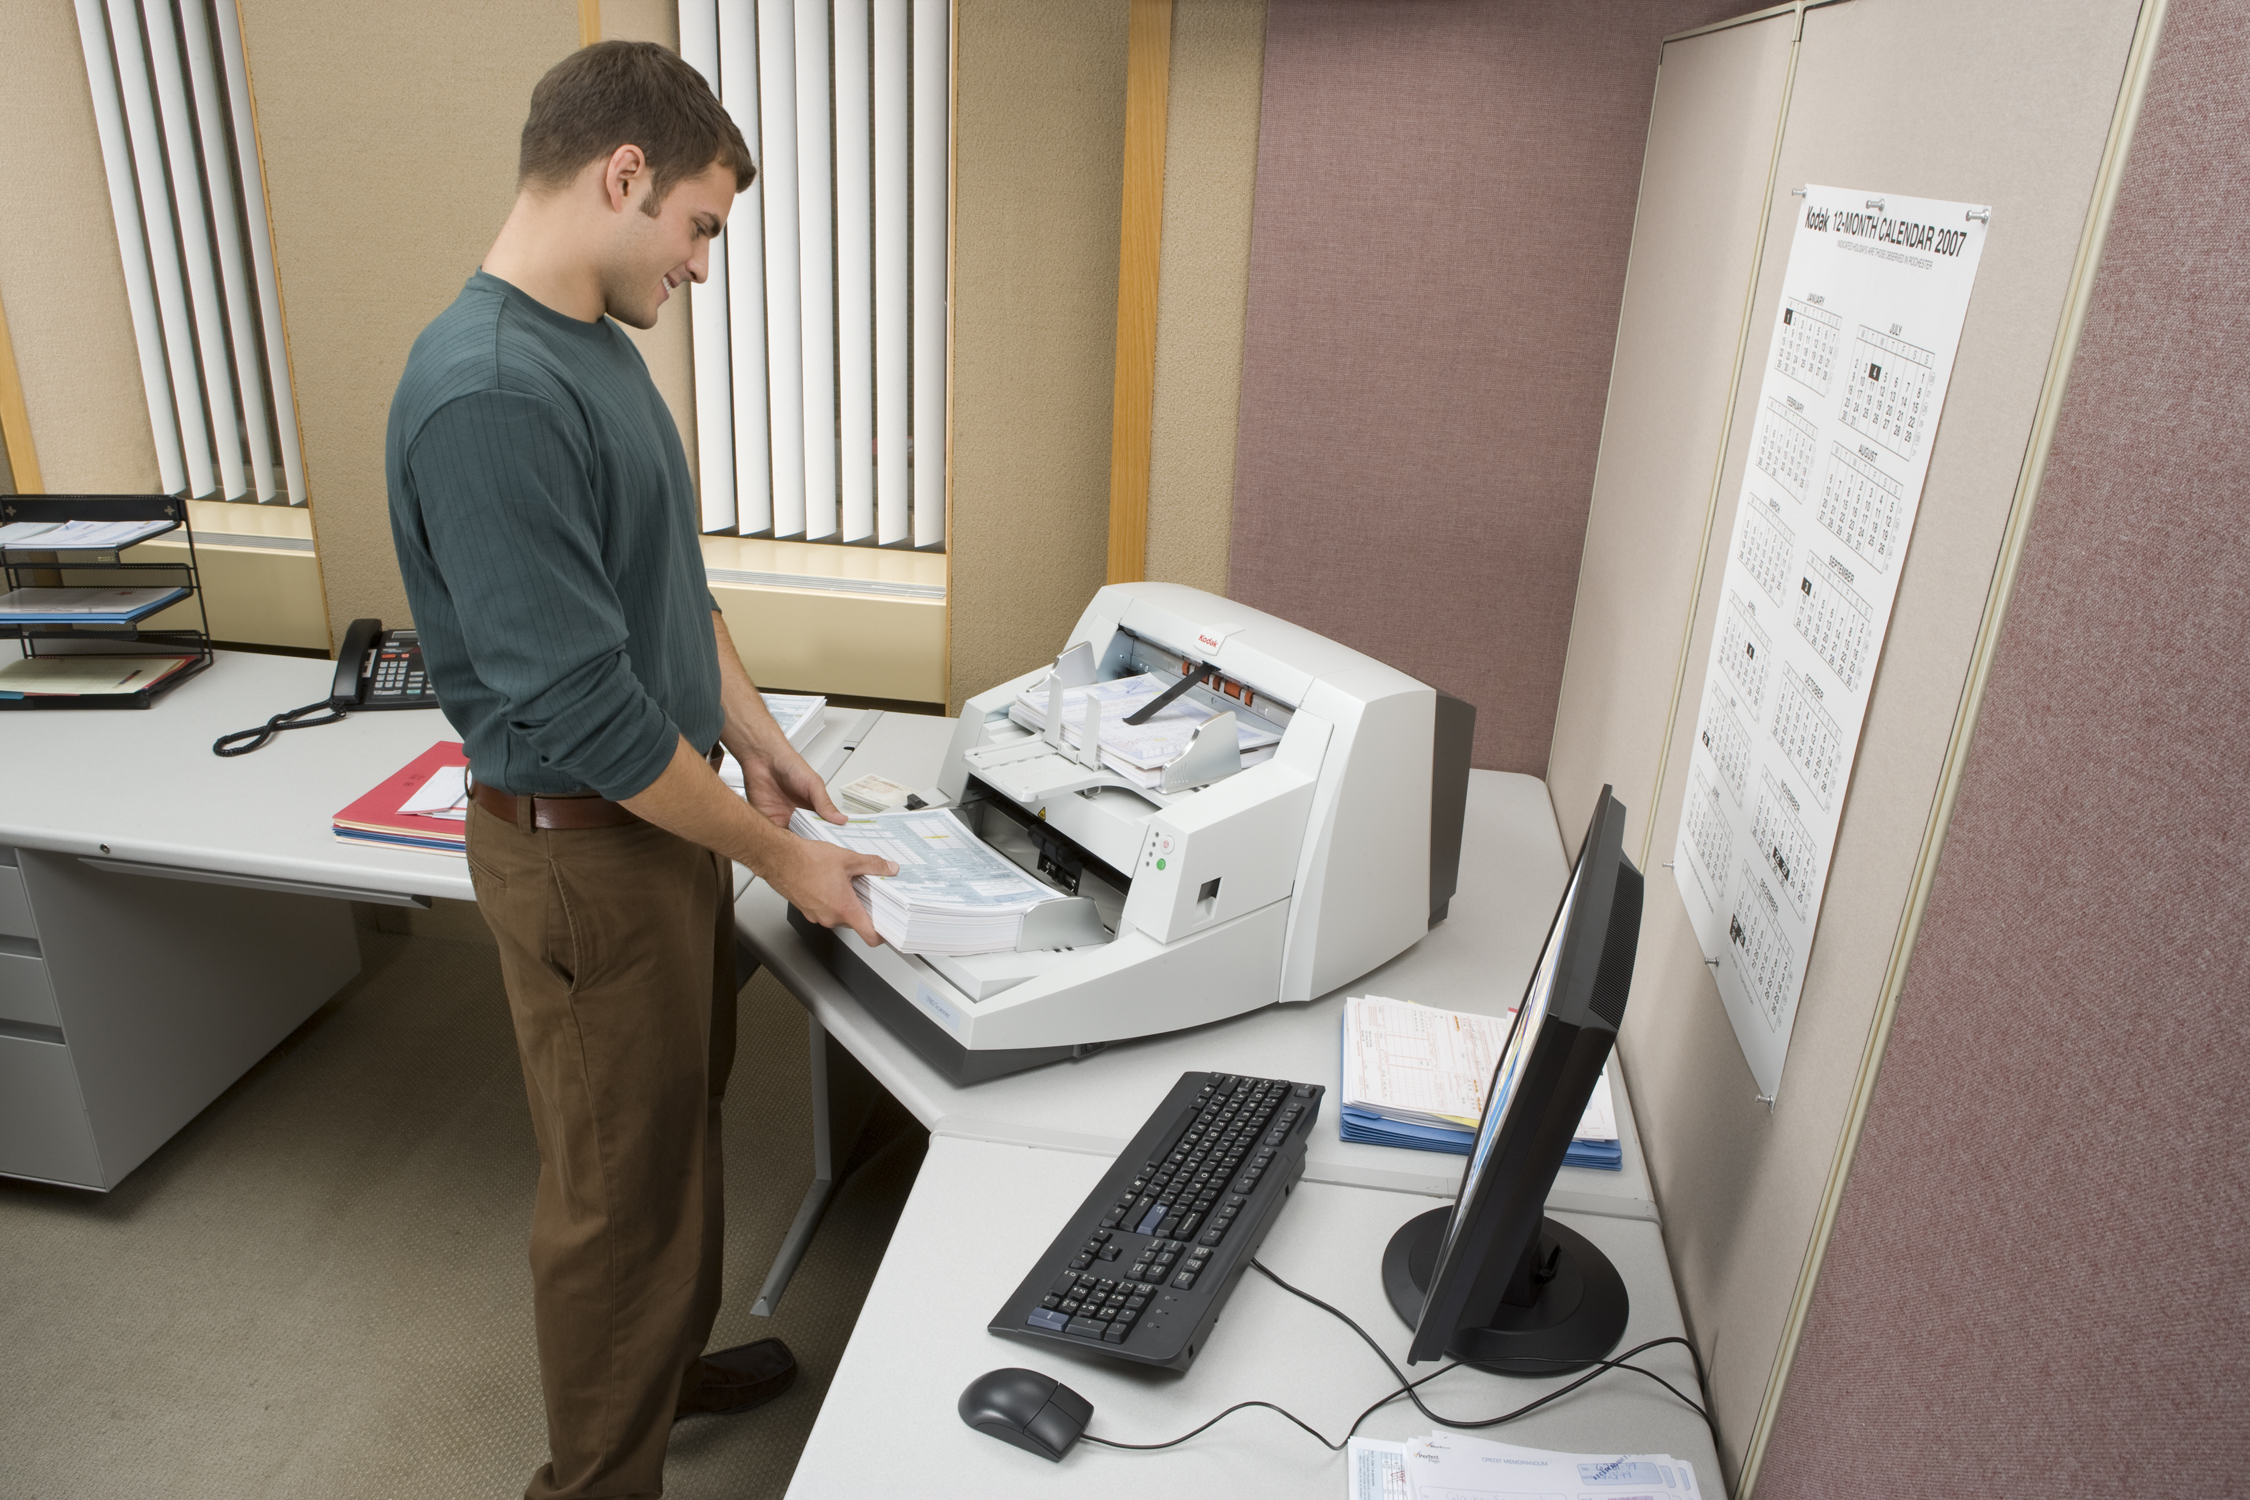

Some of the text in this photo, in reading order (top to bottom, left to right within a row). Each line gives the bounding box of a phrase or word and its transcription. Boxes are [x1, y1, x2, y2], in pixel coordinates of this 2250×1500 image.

[1805, 206, 1967, 257] Kodak 12-MONTH CALENDAR 2007
[1890, 323, 1903, 336] JULY
[1851, 372, 1856, 382] 9
[1870, 380, 1876, 391] 11
[1880, 386, 1886, 397] 12
[1890, 391, 1896, 402] 13
[1901, 396, 1908, 407] 14
[1913, 402, 1919, 414] 15
[1854, 358, 1922, 399] 2 3 4 5 6 7 8
[1921, 373, 1925, 383] 1
[1853, 402, 1860, 412] 24
[1862, 407, 1870, 419] 25
[1872, 413, 1879, 424] 26
[1882, 418, 1890, 429] 27
[1893, 424, 1901, 437] 28
[1904, 430, 1912, 442] 29
[1857, 389, 1863, 399] 17
[1867, 394, 1872, 406] 18
[1876, 400, 1882, 411] 19
[1885, 404, 1893, 416] 20
[1896, 410, 1904, 421] 21
[1908, 416, 1916, 428] 22
[1859, 444, 1878, 463] AUGUST
[1850, 474, 1894, 513] 1 2 3 4 5
[1829, 555, 1854, 585] SEPTEMBER
[1198, 634, 1218, 648] Kodak
[1805, 674, 1824, 702] OCTOBER
